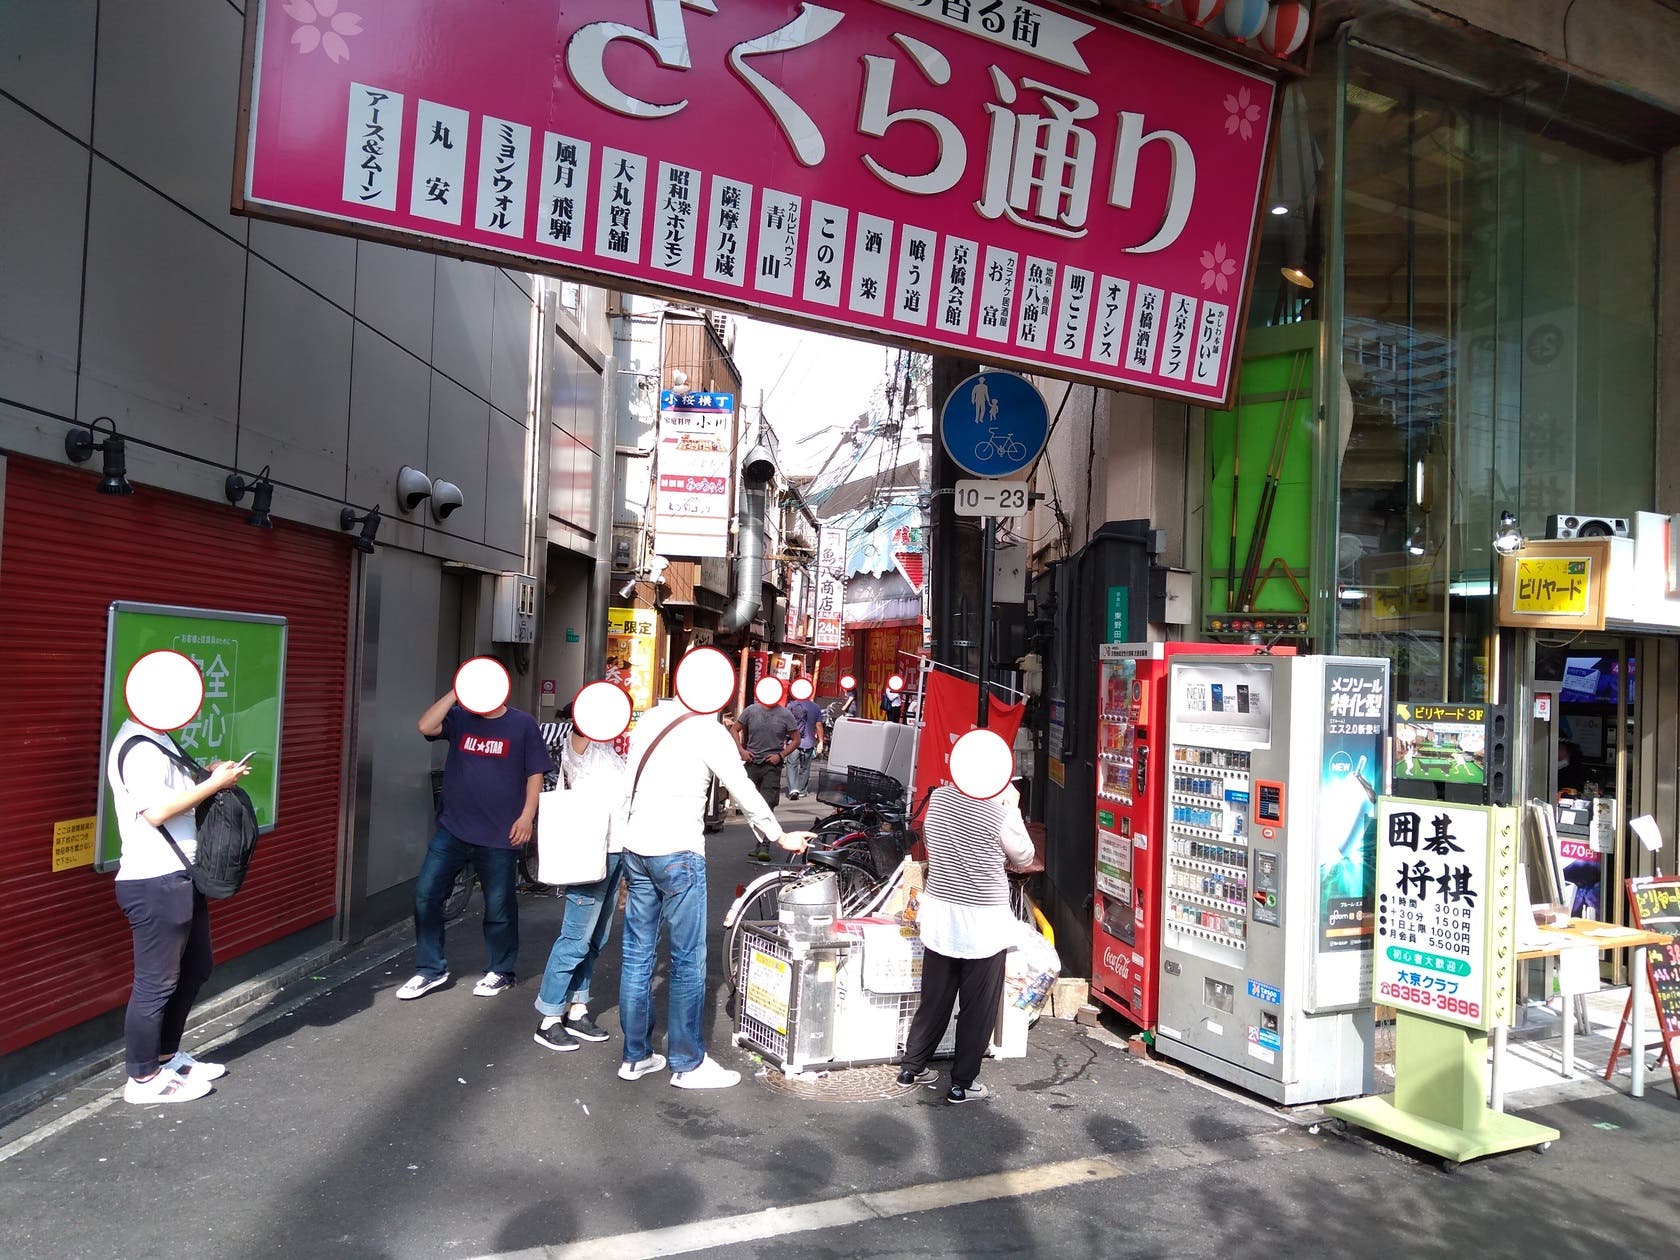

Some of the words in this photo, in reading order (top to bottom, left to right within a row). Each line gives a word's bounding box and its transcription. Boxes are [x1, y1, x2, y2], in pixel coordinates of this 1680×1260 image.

[425, 120, 454, 205] 丸安
[608, 158, 635, 253] 大丸質舗
[715, 185, 741, 277] 薩摩乃蔵
[783, 201, 798, 268] カルビハウス
[762, 205, 785, 279] 青山
[815, 217, 835, 290] このみ
[860, 229, 883, 300] 酒楽
[904, 239, 927, 313] 喰う道
[945, 245, 969, 326] 京橋会館
[983, 261, 1003, 327] お富
[1000, 257, 1015, 327] カラオケ居酒屋
[1021, 263, 1043, 342] 魚八商店
[1063, 274, 1085, 349] 明ごころ
[1100, 284, 1121, 357] オアシス
[1134, 292, 1156, 366] 京橋酒場
[1167, 298, 1190, 374] 大京クラブ
[1197, 308, 1216, 378] とりいし
[664, 393, 729, 407] 小桜横丁
[1519, 578, 1582, 600] ビリヤード
[1330, 677, 1382, 692] メンソール
[1330, 692, 1382, 717] 特化型
[1414, 706, 1466, 720] ビリヤード
[1467, 709, 1484, 721] 3F
[463, 736, 478, 751] ALL
[484, 740, 504, 754] STAR
[1388, 811, 1466, 856] 囲碁
[1391, 895, 1418, 909] 1時間
[1434, 903, 1471, 918] 300円
[1396, 859, 1478, 908] 将棋
[1389, 929, 1417, 943] 月会員
[1390, 918, 1426, 933] 1日上限
[1435, 916, 1471, 932] 150円
[1397, 970, 1459, 994] 大京クラブ
